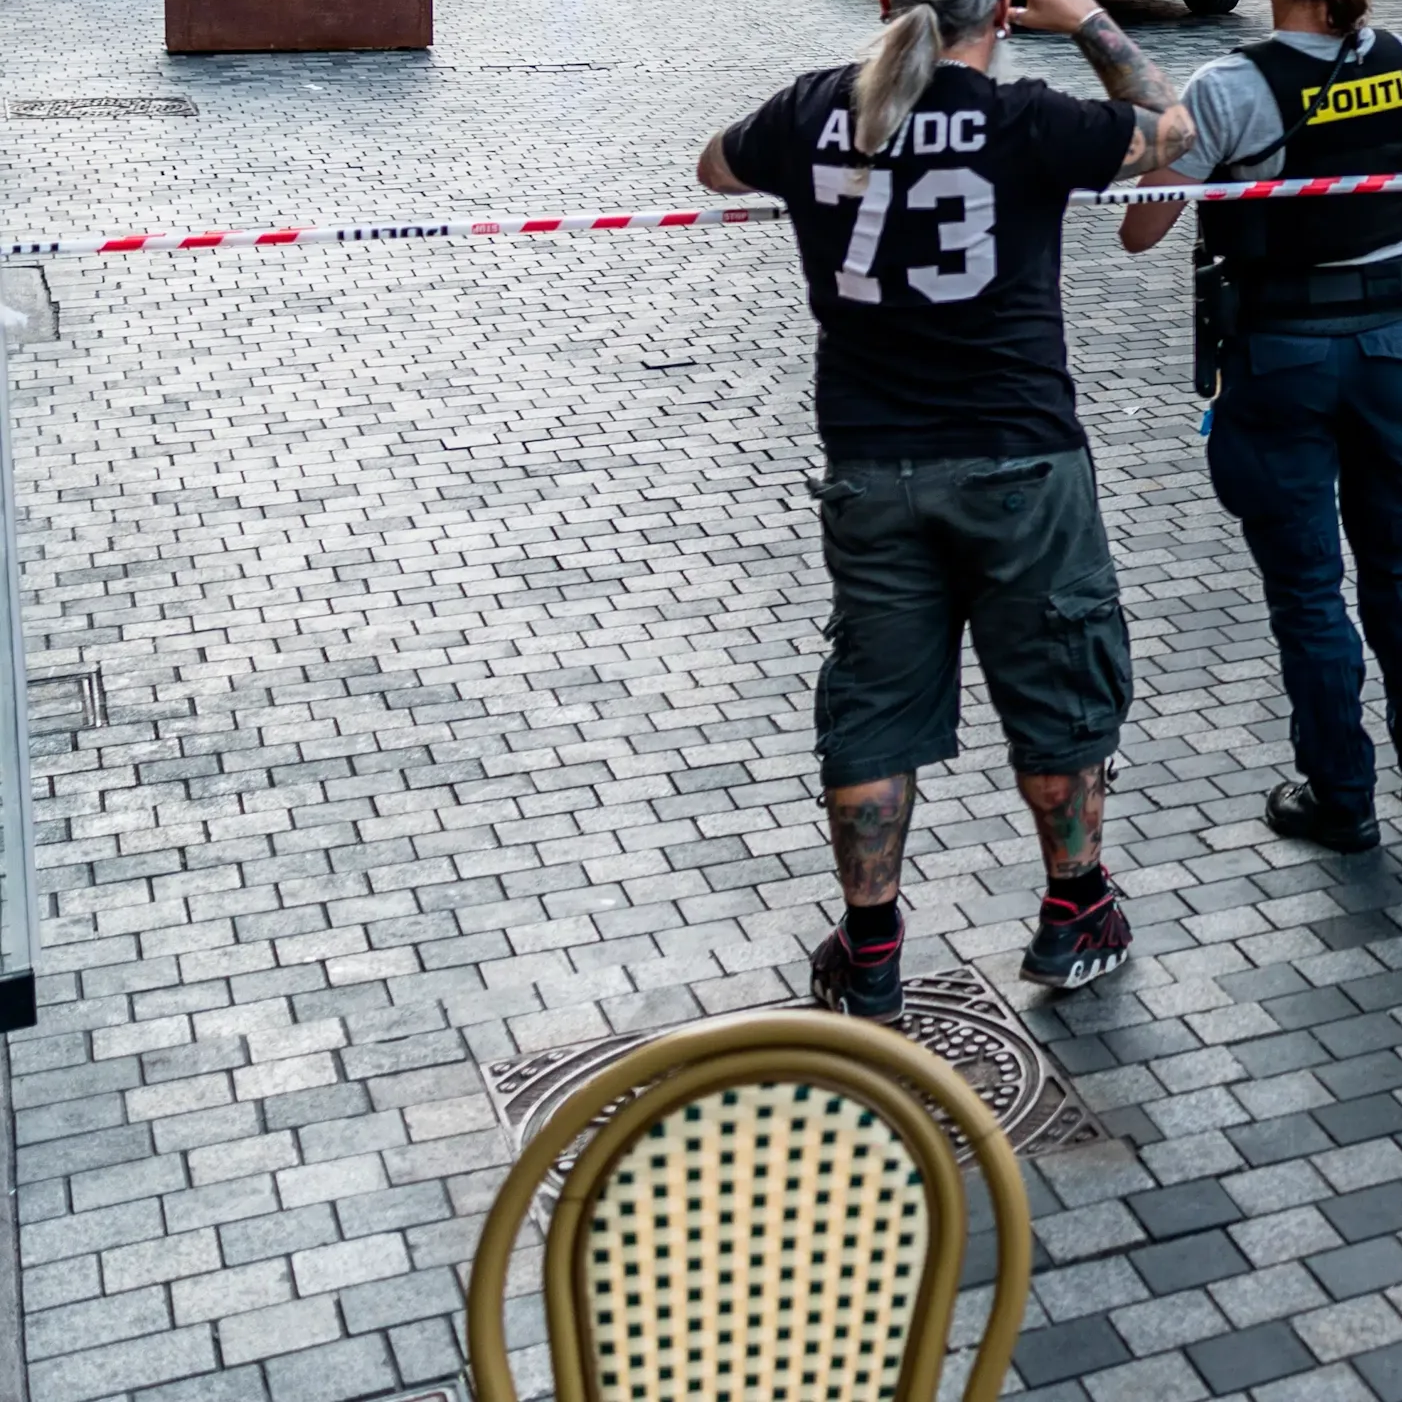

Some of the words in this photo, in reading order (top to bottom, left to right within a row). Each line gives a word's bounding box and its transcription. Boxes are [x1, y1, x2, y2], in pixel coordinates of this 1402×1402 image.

[816, 109, 987, 158] A/DC
[724, 210, 749, 222] STOP
[812, 163, 998, 304] 73
